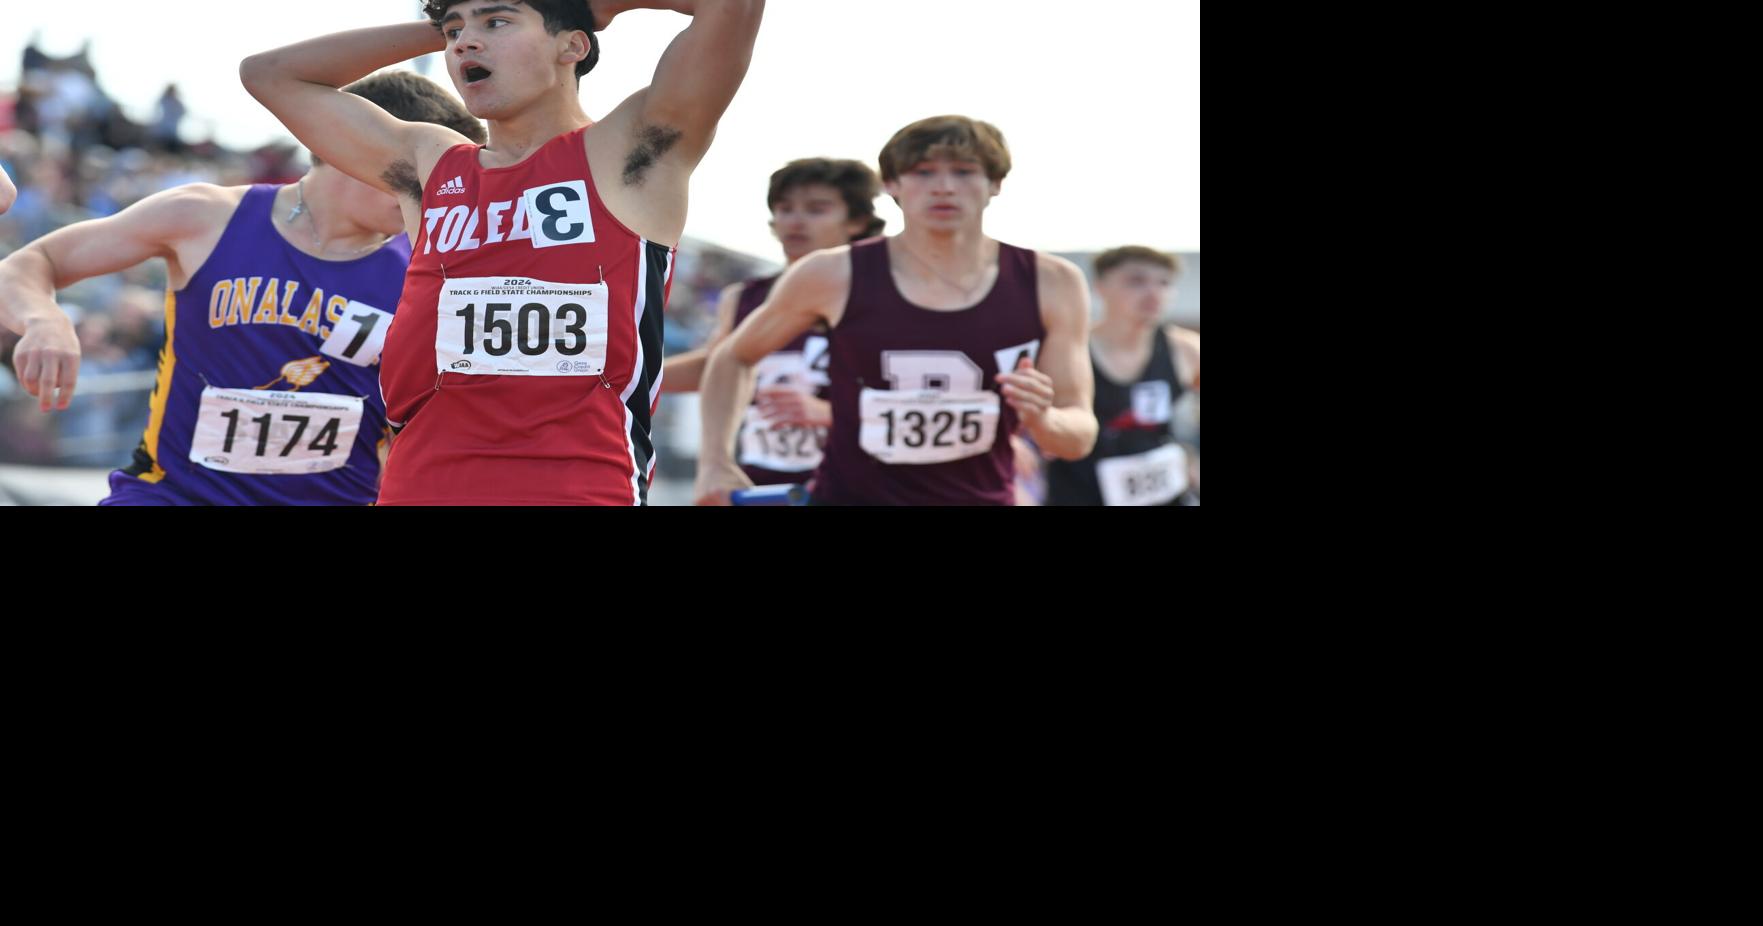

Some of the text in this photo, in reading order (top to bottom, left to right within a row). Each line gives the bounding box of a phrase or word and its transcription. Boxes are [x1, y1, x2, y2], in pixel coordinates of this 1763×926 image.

[437, 186, 466, 195] adidas
[535, 186, 585, 242] 3
[208, 276, 348, 341] ONALAS
[456, 302, 587, 356] 1503
[341, 312, 381, 359] 1
[221, 409, 341, 457] 1174
[879, 408, 983, 448] 1325
